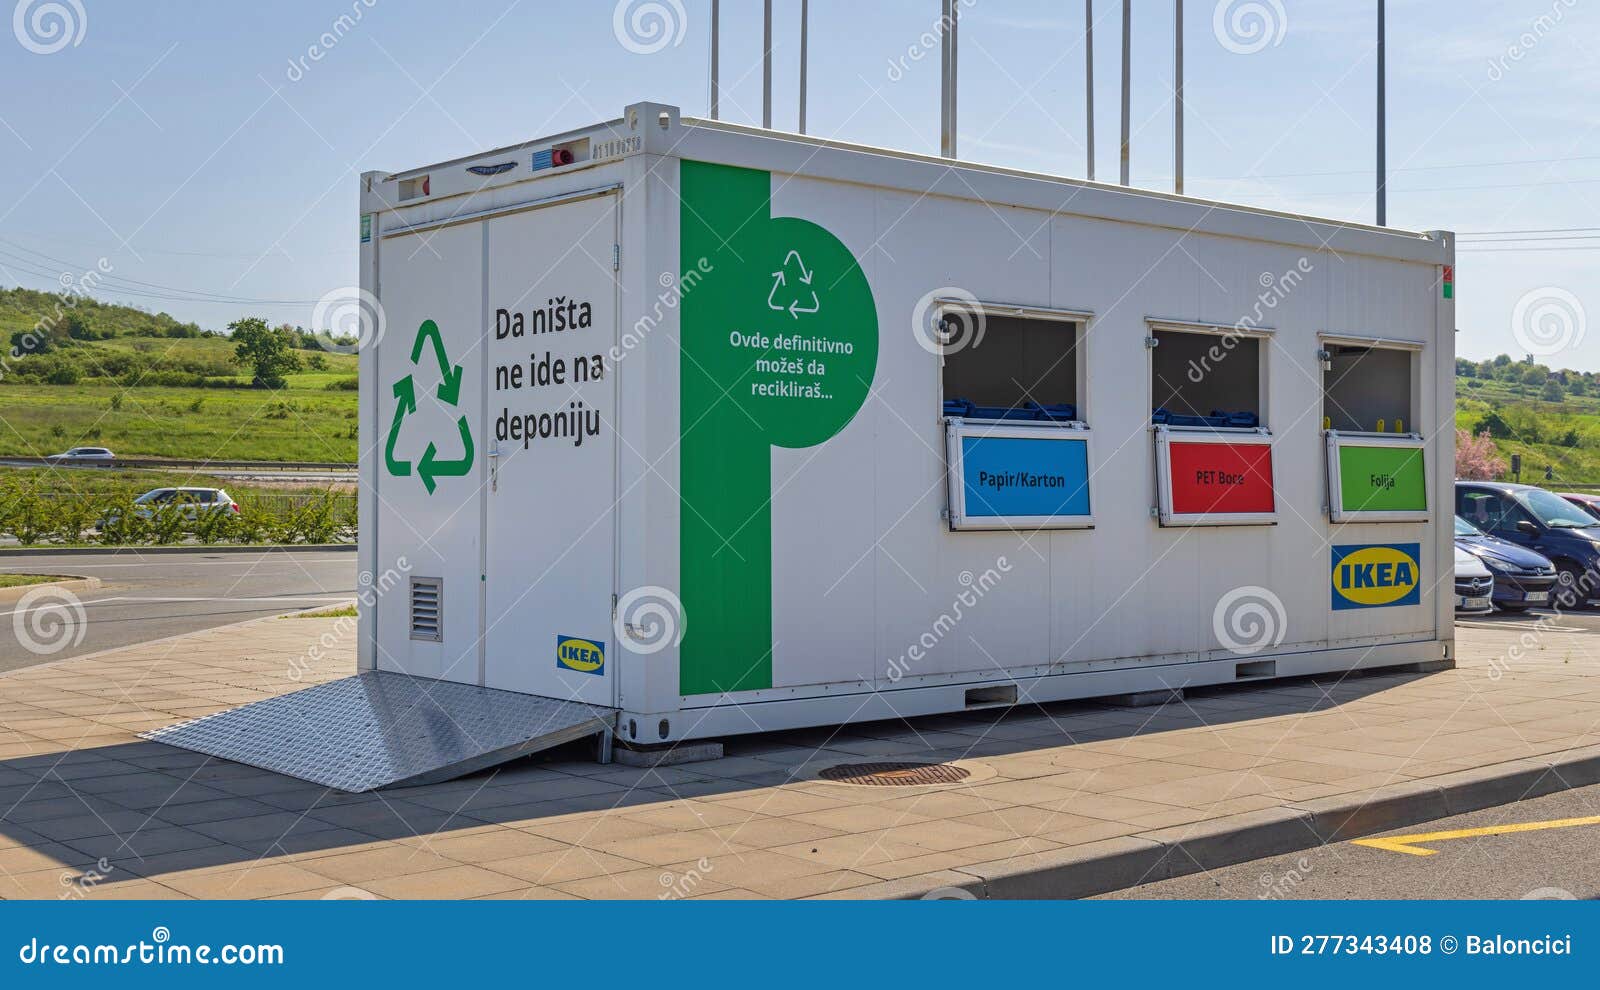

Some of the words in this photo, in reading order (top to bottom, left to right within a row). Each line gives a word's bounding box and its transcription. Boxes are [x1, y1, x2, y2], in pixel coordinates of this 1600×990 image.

[496, 308, 524, 340] Da
[532, 296, 592, 334] ništa
[729, 331, 769, 349] Ovde
[773, 334, 853, 354] definitivno
[496, 363, 523, 390] ne
[530, 352, 566, 386] ide
[574, 354, 604, 382] na
[756, 357, 803, 374] možeš
[807, 360, 825, 375] da
[751, 380, 833, 399] recikliraš...
[495, 401, 600, 449] deponiju
[980, 471, 1065, 491] Papir/Karton
[1196, 471, 1216, 485] PET
[1219, 472, 1244, 485] Boce
[1370, 474, 1395, 490] Folija
[1341, 562, 1413, 589] IKEA
[562, 646, 601, 665] IKEA
